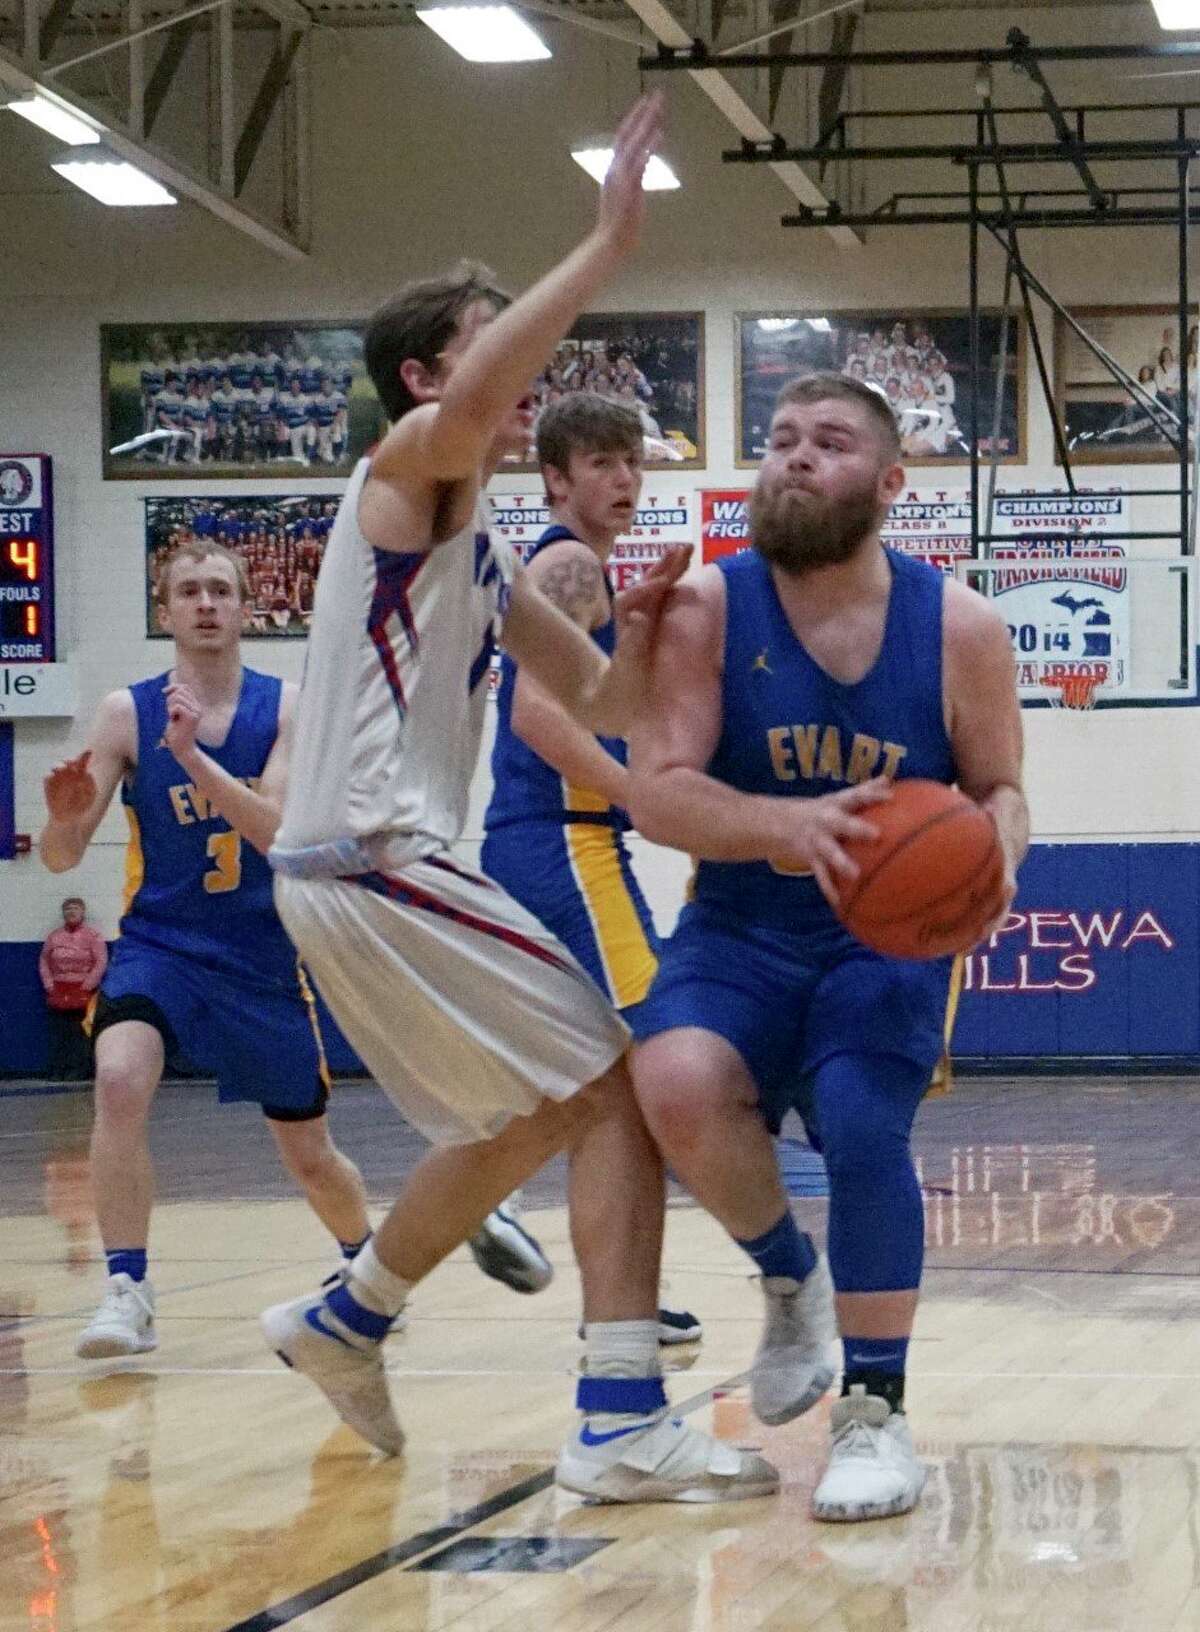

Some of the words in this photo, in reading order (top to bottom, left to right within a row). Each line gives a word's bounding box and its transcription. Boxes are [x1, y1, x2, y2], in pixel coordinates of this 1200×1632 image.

[1000, 501, 1120, 514] CHAMPIONS
[1012, 517, 1092, 527] DIVISION
[10, 542, 36, 580] 4
[1, 644, 43, 657] SCORE
[768, 724, 908, 784] EVART
[204, 831, 242, 894] 3
[964, 954, 1096, 990] ILLS
